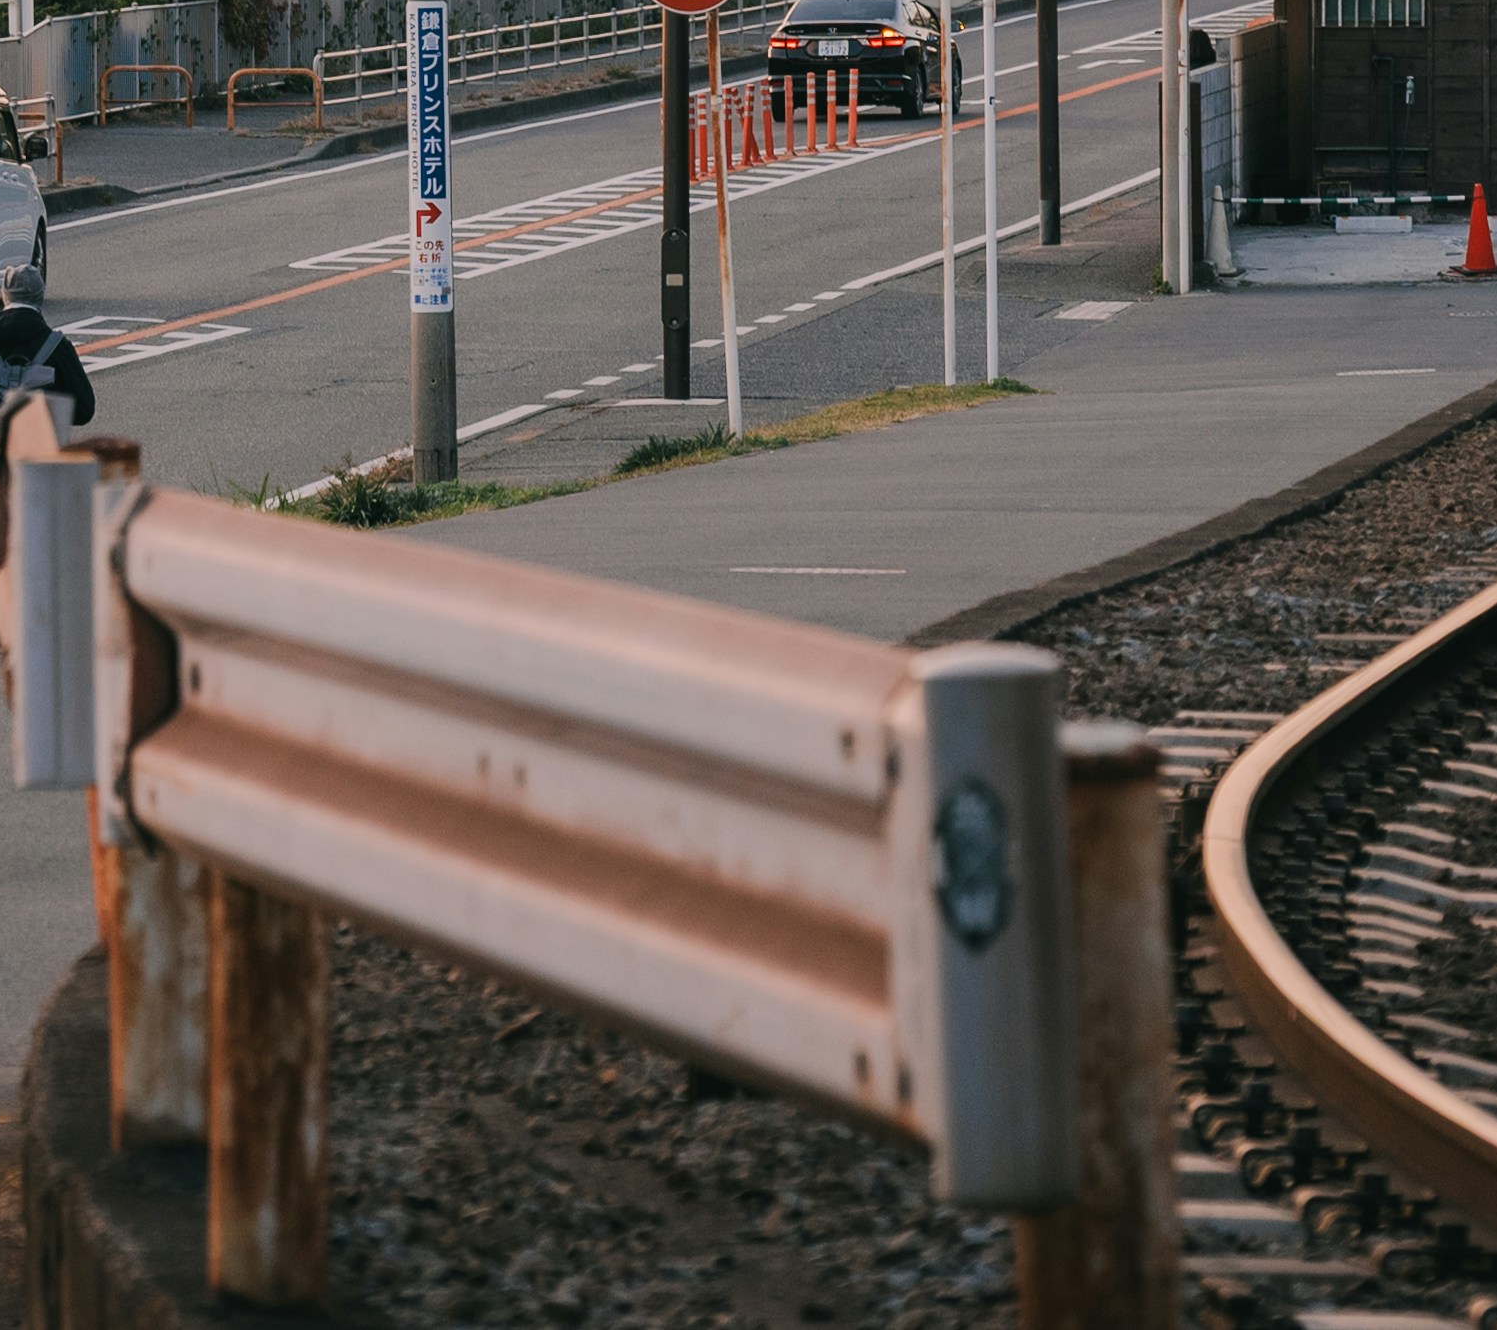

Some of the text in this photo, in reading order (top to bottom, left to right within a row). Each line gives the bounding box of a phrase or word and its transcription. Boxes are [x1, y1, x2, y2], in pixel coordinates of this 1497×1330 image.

[421, 11, 443, 196] 鎌倉プリンスホテル
[416, 241, 444, 251] この先
